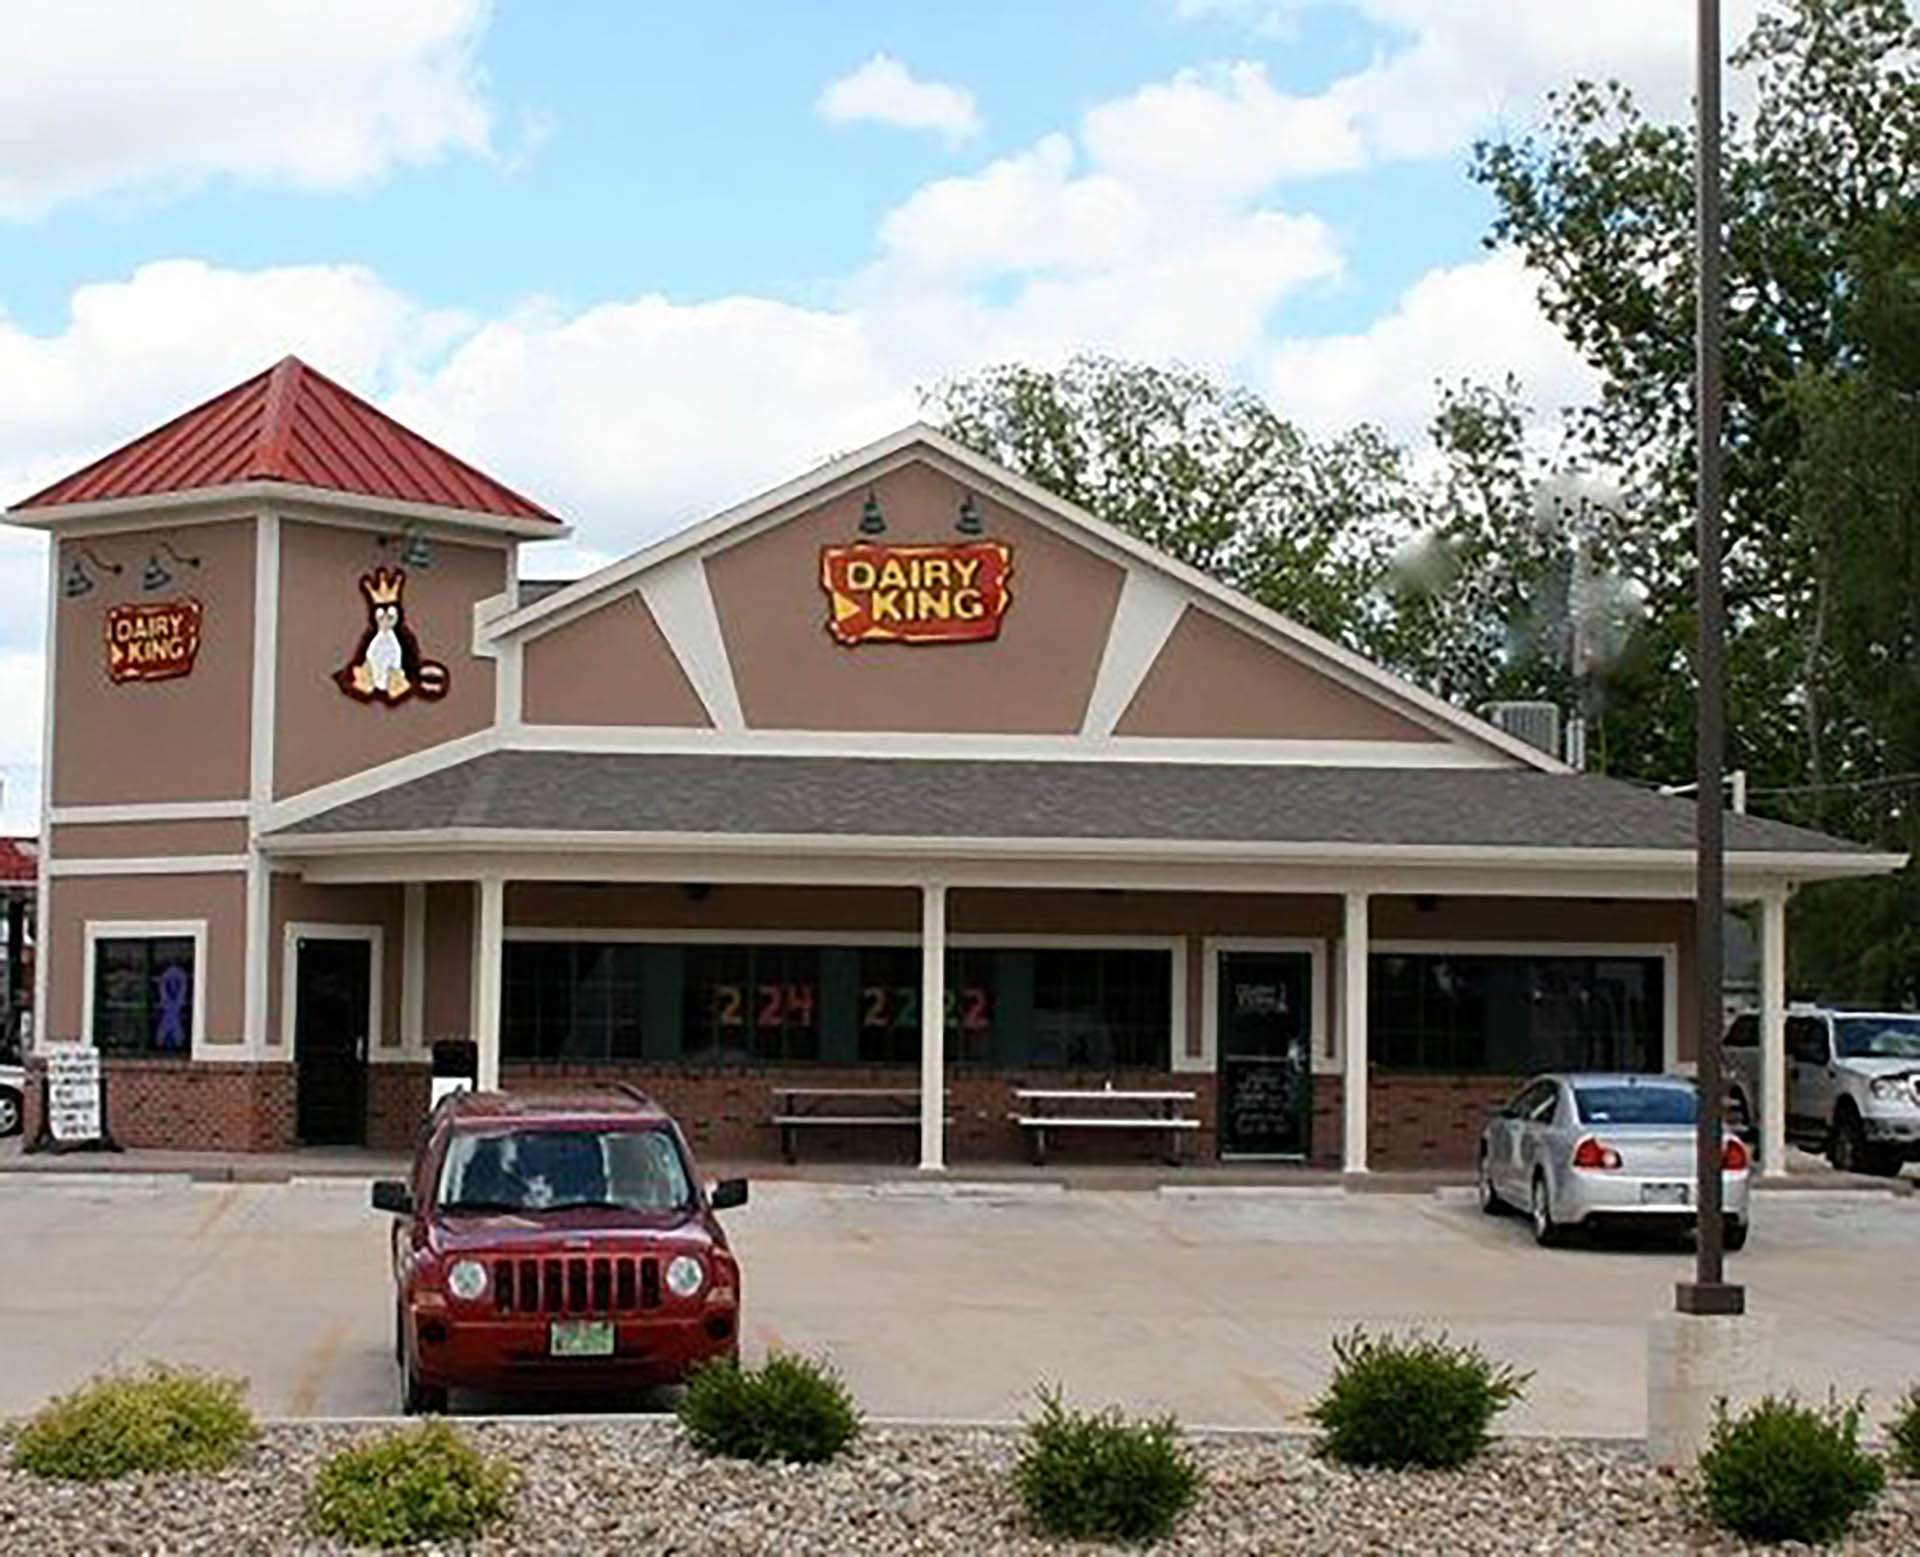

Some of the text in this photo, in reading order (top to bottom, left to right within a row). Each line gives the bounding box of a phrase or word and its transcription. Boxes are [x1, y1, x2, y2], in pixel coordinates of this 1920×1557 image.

[847, 558, 979, 590] DAIRY
[871, 589, 984, 619] KING
[116, 613, 183, 643] DAIRY
[127, 637, 185, 663] KING
